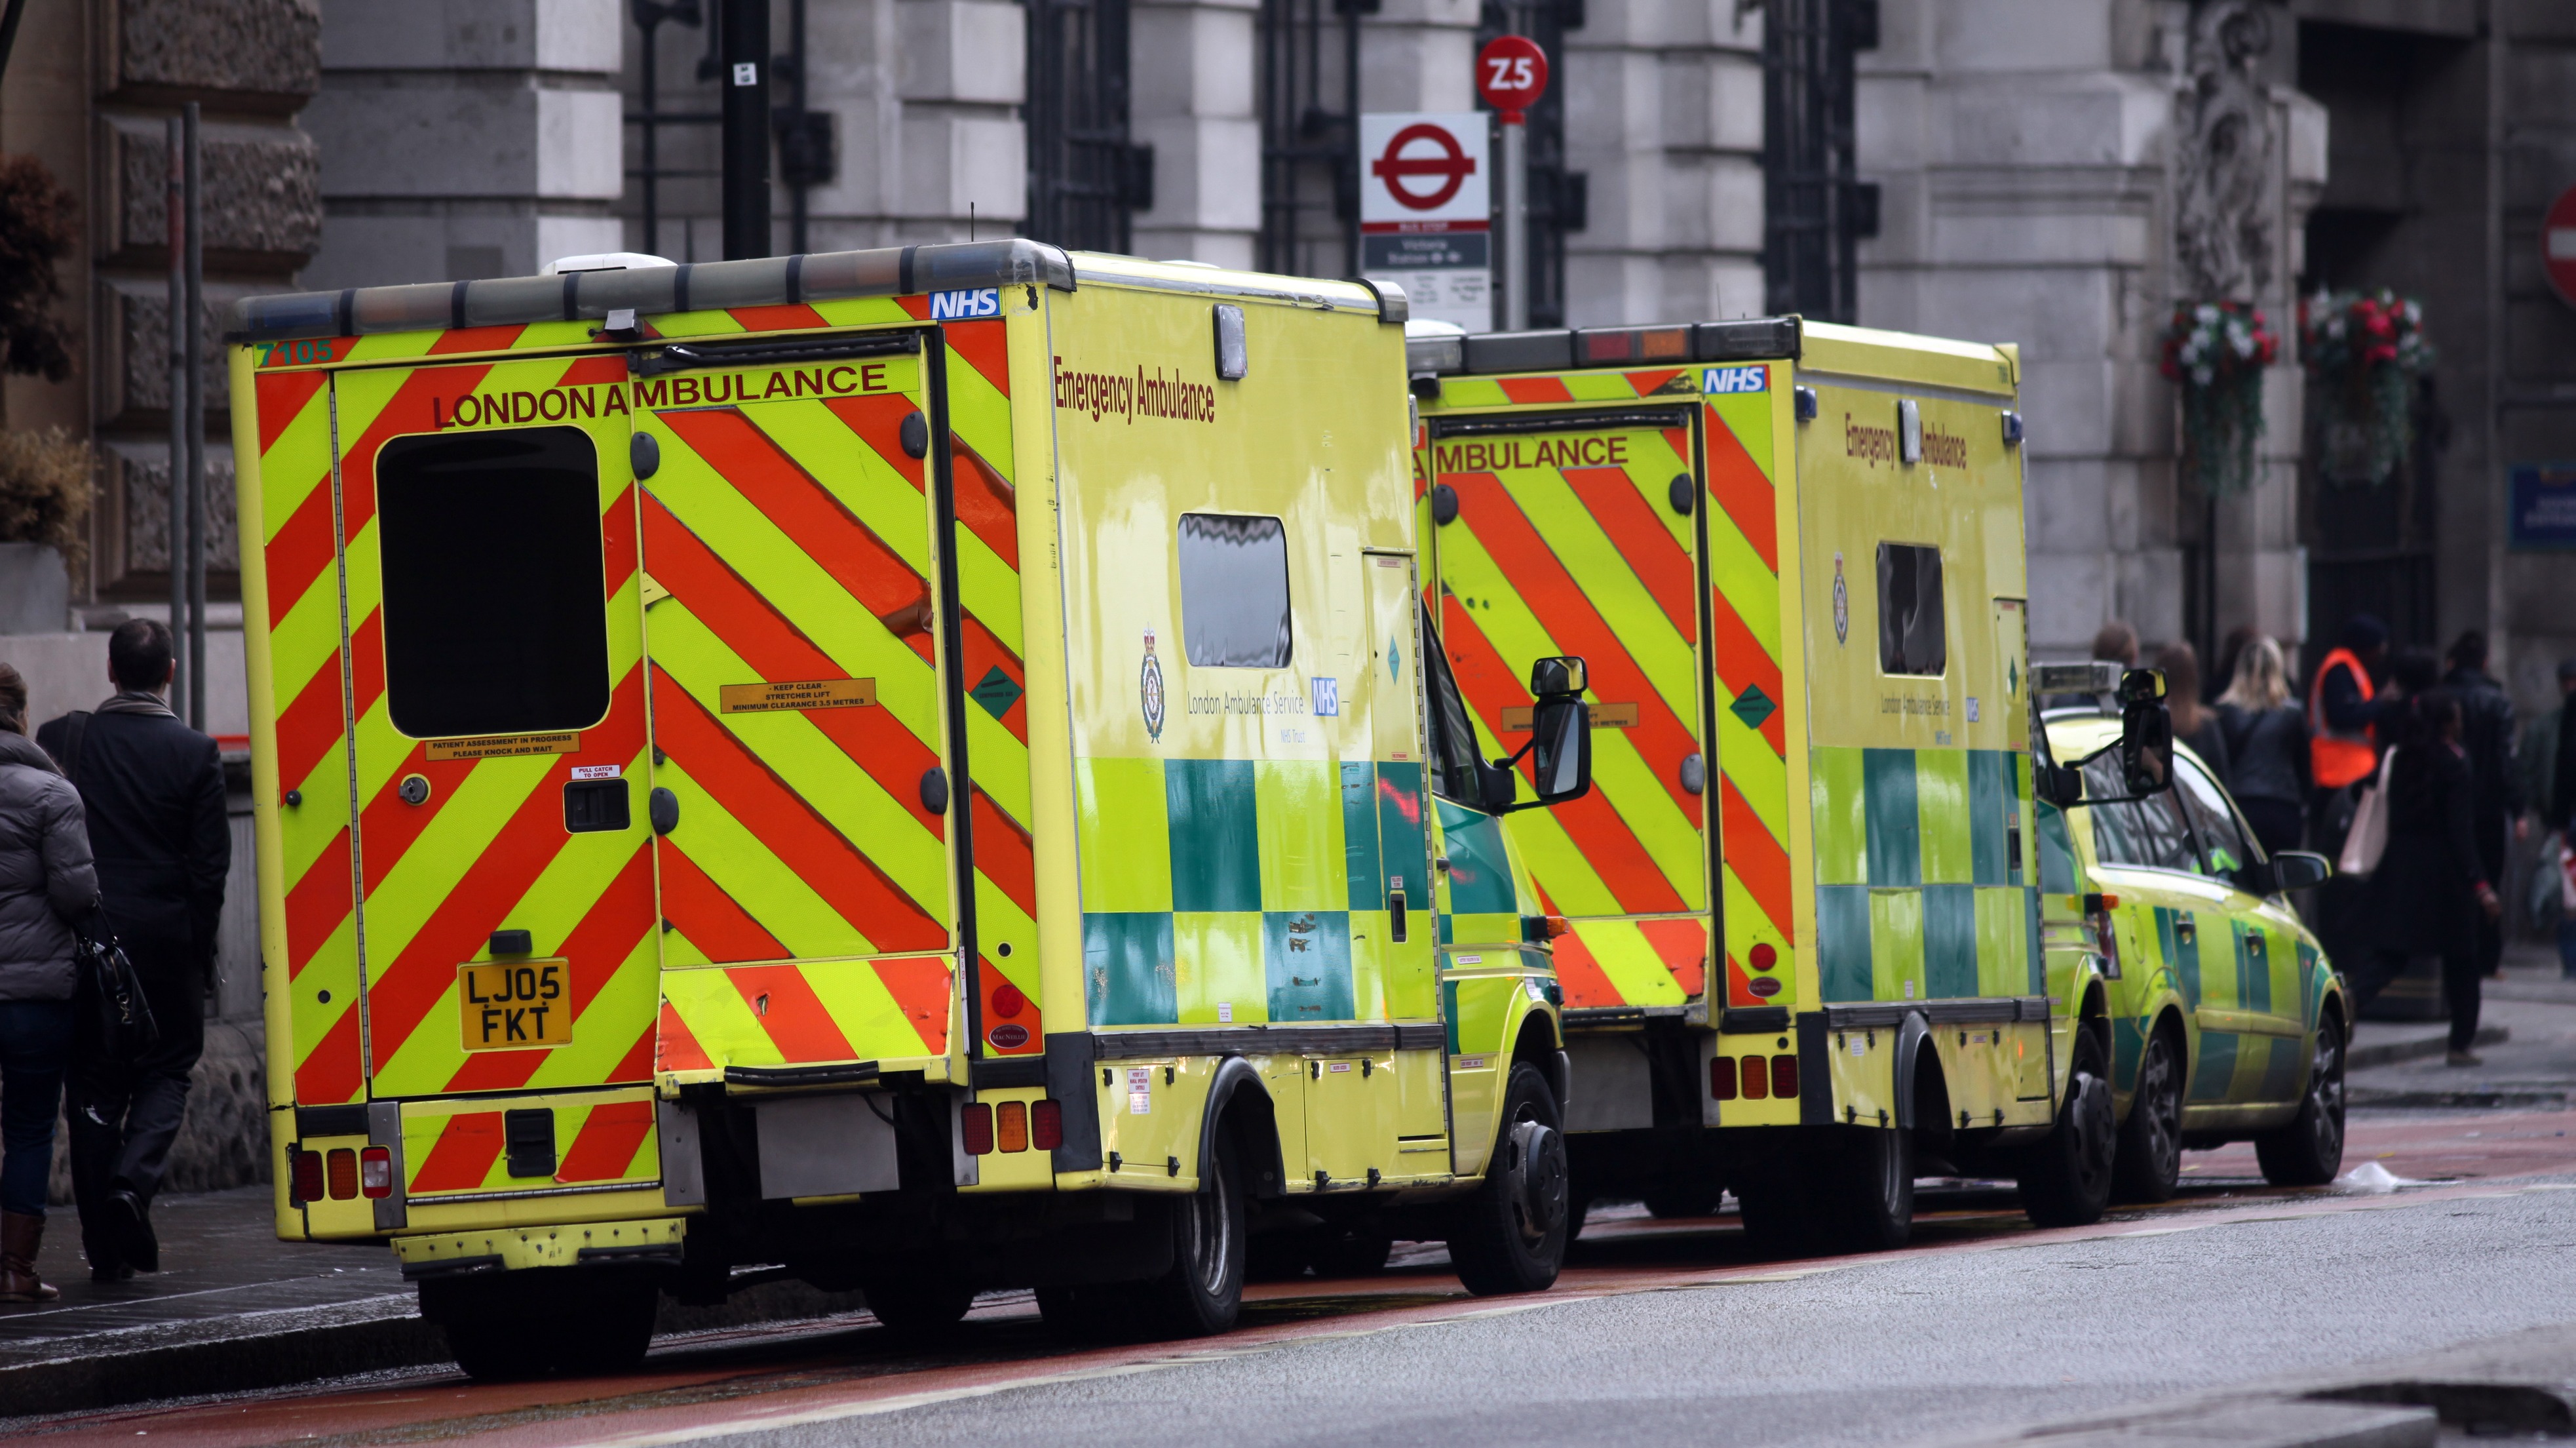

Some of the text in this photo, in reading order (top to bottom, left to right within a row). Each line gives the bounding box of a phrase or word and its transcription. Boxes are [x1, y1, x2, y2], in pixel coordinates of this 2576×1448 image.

[1488, 58, 1533, 90] Z5
[932, 288, 997, 319] NHS
[256, 340, 333, 366] 7105
[433, 364, 888, 428] LONDON AMBULANCE
[1053, 356, 1215, 425] Emergency Ambulance
[1704, 367, 1763, 393] NHS
[1845, 412, 1894, 471] Emergency
[1187, 690, 1221, 714] London
[1224, 690, 1271, 714] Ambulance
[1274, 690, 1304, 714] Service
[1313, 680, 1337, 714] NHS
[1967, 698, 1978, 722] NHS
[467, 738, 518, 747] ASSESSMENT
[1280, 729, 1305, 743] NHS Trust
[468, 966, 560, 1004] LJ05
[482, 1007, 548, 1042] FKT
